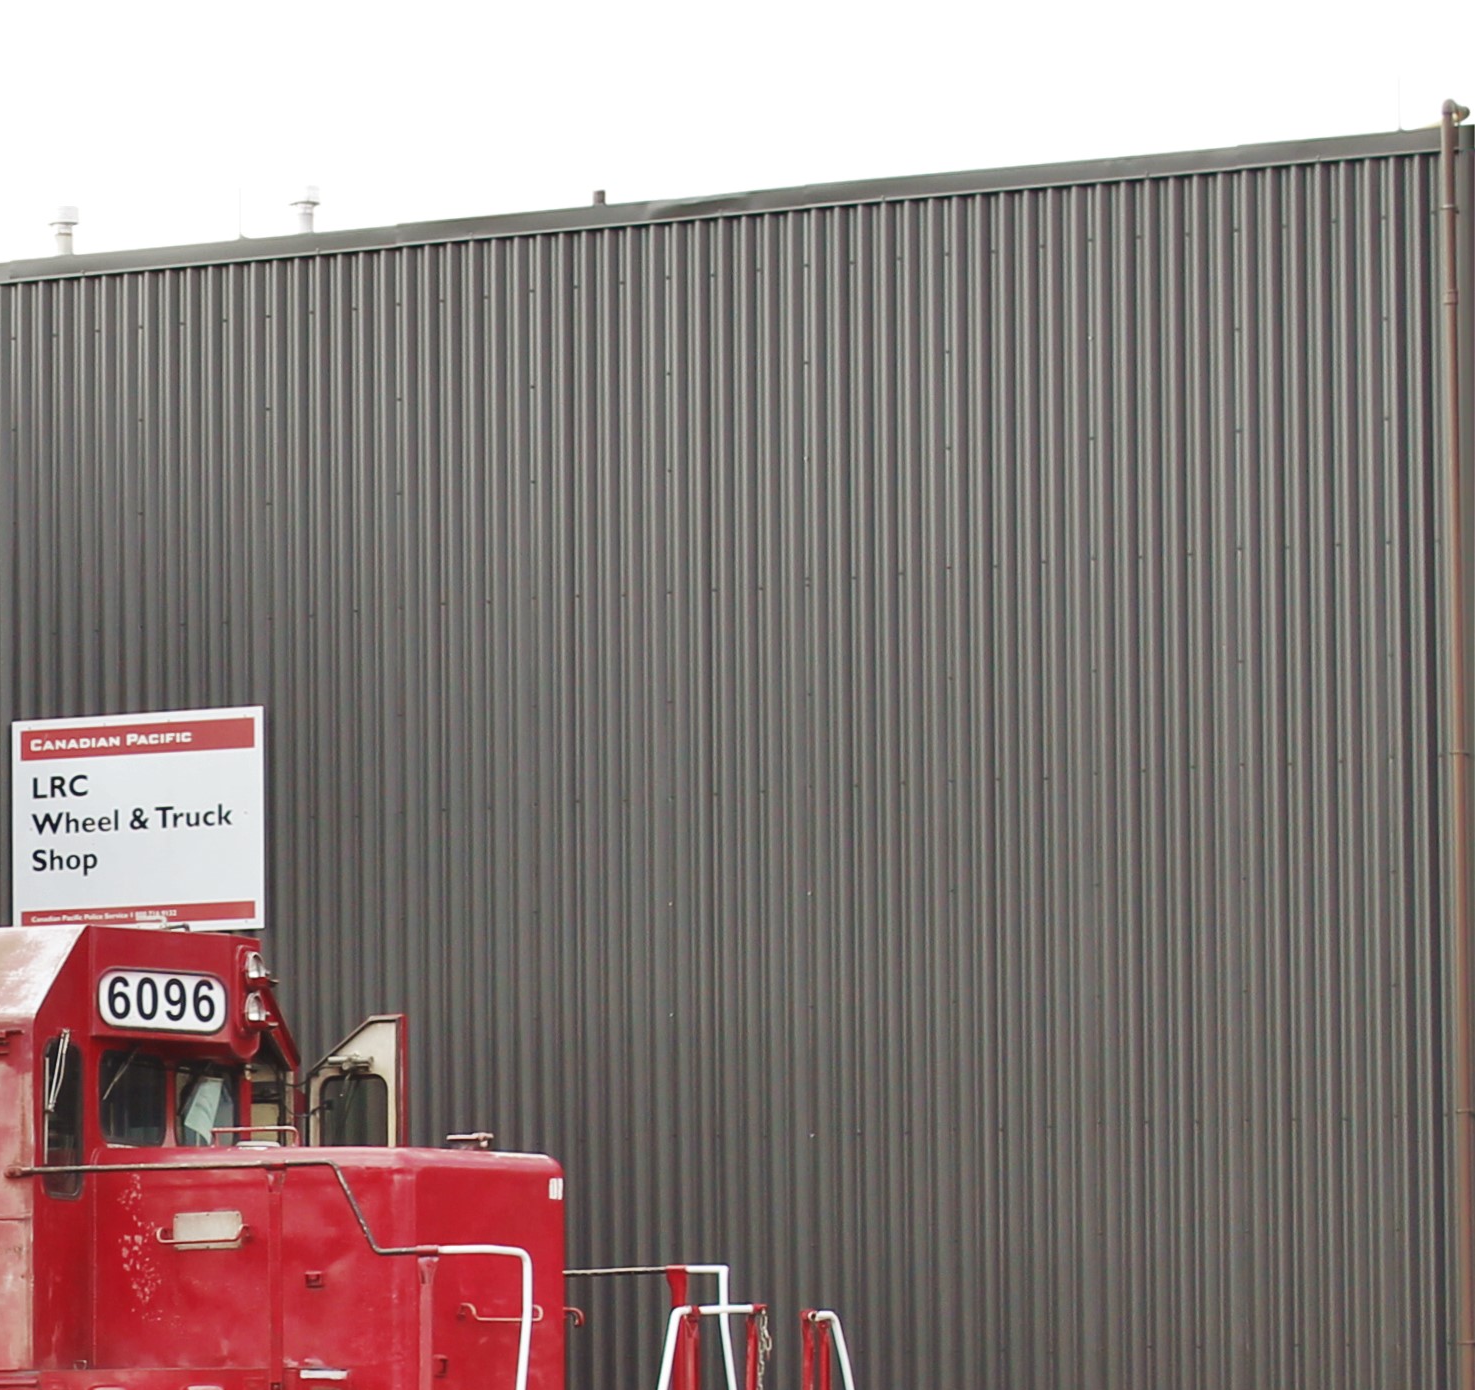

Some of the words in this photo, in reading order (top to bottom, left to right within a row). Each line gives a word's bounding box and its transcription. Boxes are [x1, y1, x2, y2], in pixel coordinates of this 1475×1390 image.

[32, 774, 89, 799] LRC
[32, 809, 119, 835] Wheel
[129, 807, 149, 830] &
[155, 804, 233, 829] Truck
[32, 849, 98, 876] Shop
[62, 914, 82, 922] Pacific
[84, 913, 103, 921] Police
[104, 912, 128, 920] Service
[106, 977, 217, 1022] 6096
